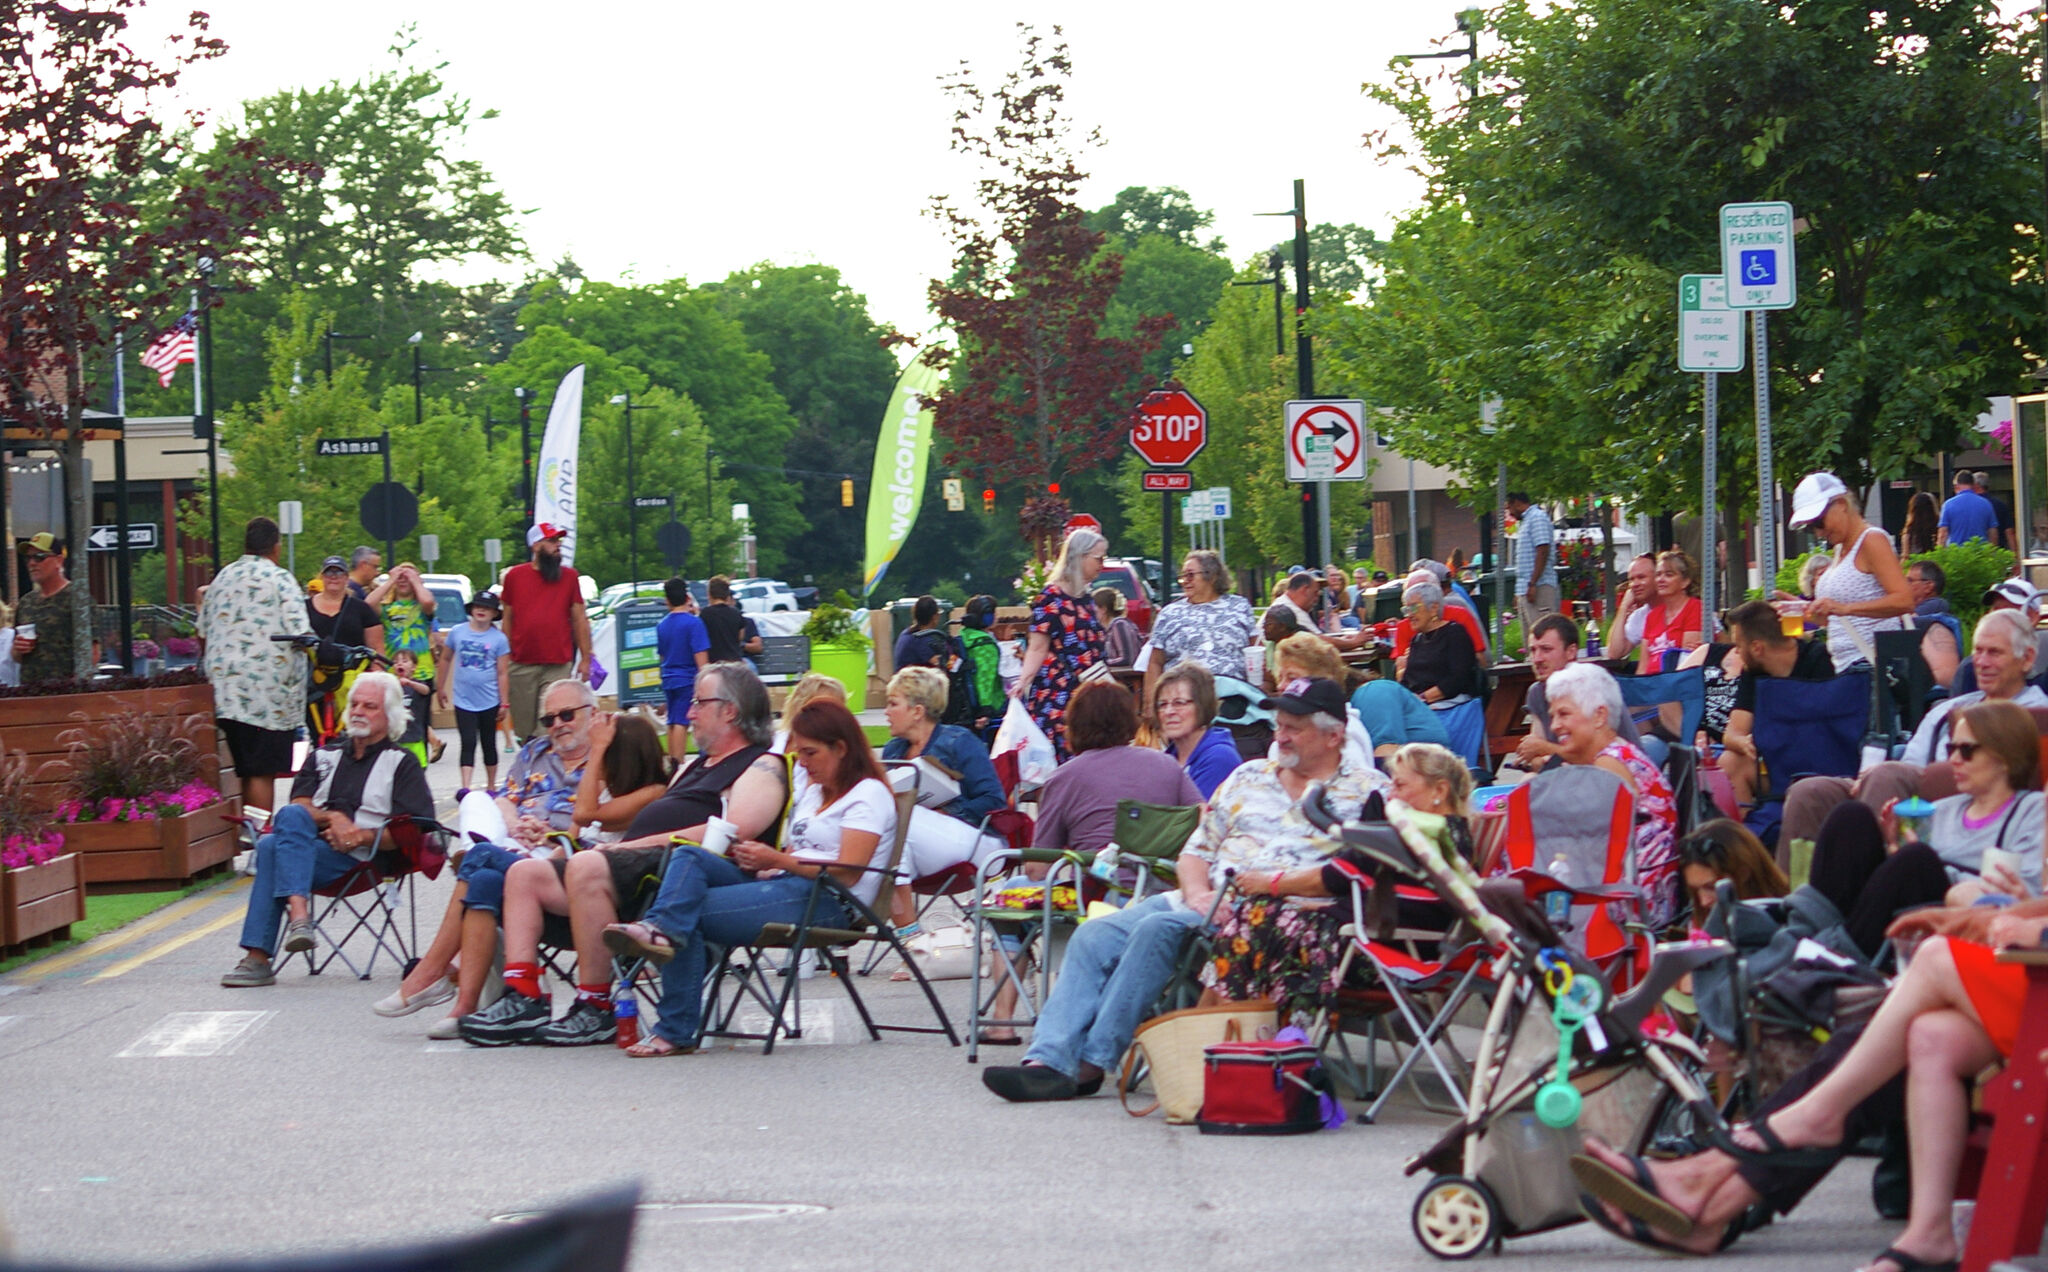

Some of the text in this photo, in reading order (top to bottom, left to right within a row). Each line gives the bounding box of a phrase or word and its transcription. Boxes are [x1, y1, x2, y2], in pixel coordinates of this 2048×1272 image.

[1727, 213, 1786, 228] RESERVED
[1729, 231, 1784, 245] PARKING
[1685, 285, 1697, 303] 3
[1746, 289, 1772, 301] ONLY
[1136, 414, 1199, 442] STOP
[319, 440, 379, 454] Ashman
[1149, 477, 1166, 486] ALL
[635, 497, 668, 507] Gordon
